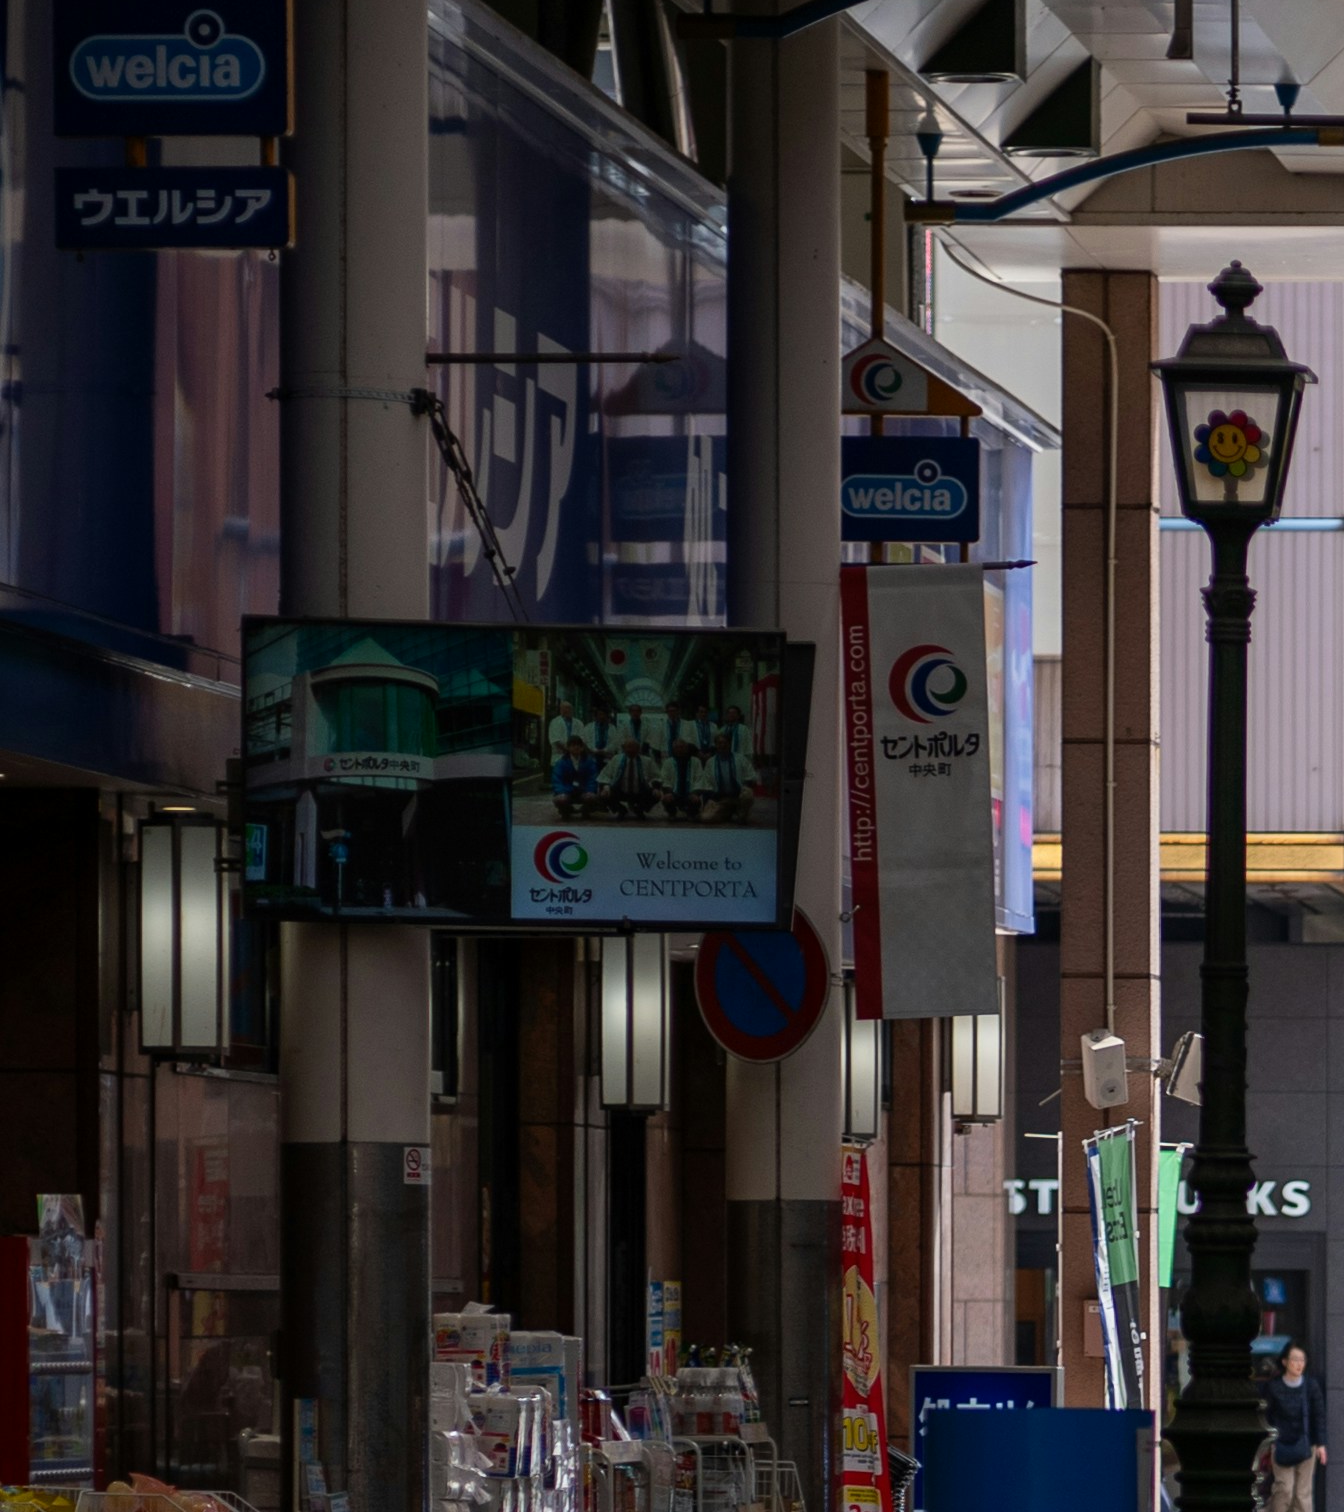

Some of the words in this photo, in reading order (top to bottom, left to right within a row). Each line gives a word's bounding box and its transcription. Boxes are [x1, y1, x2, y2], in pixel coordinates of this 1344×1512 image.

[85, 44, 242, 90] welcia
[72, 188, 273, 227] ウエルシア
[847, 480, 951, 513] welcia
[848, 624, 873, 862] http://centporta.com
[880, 731, 980, 760] セントポルタ
[908, 761, 952, 777] 中央町
[636, 849, 719, 871] Welcome
[724, 855, 743, 871] to
[529, 887, 593, 904] セントポルタ
[619, 879, 758, 899] CENTPORTA
[1003, 1178, 1312, 1217] STUKS
